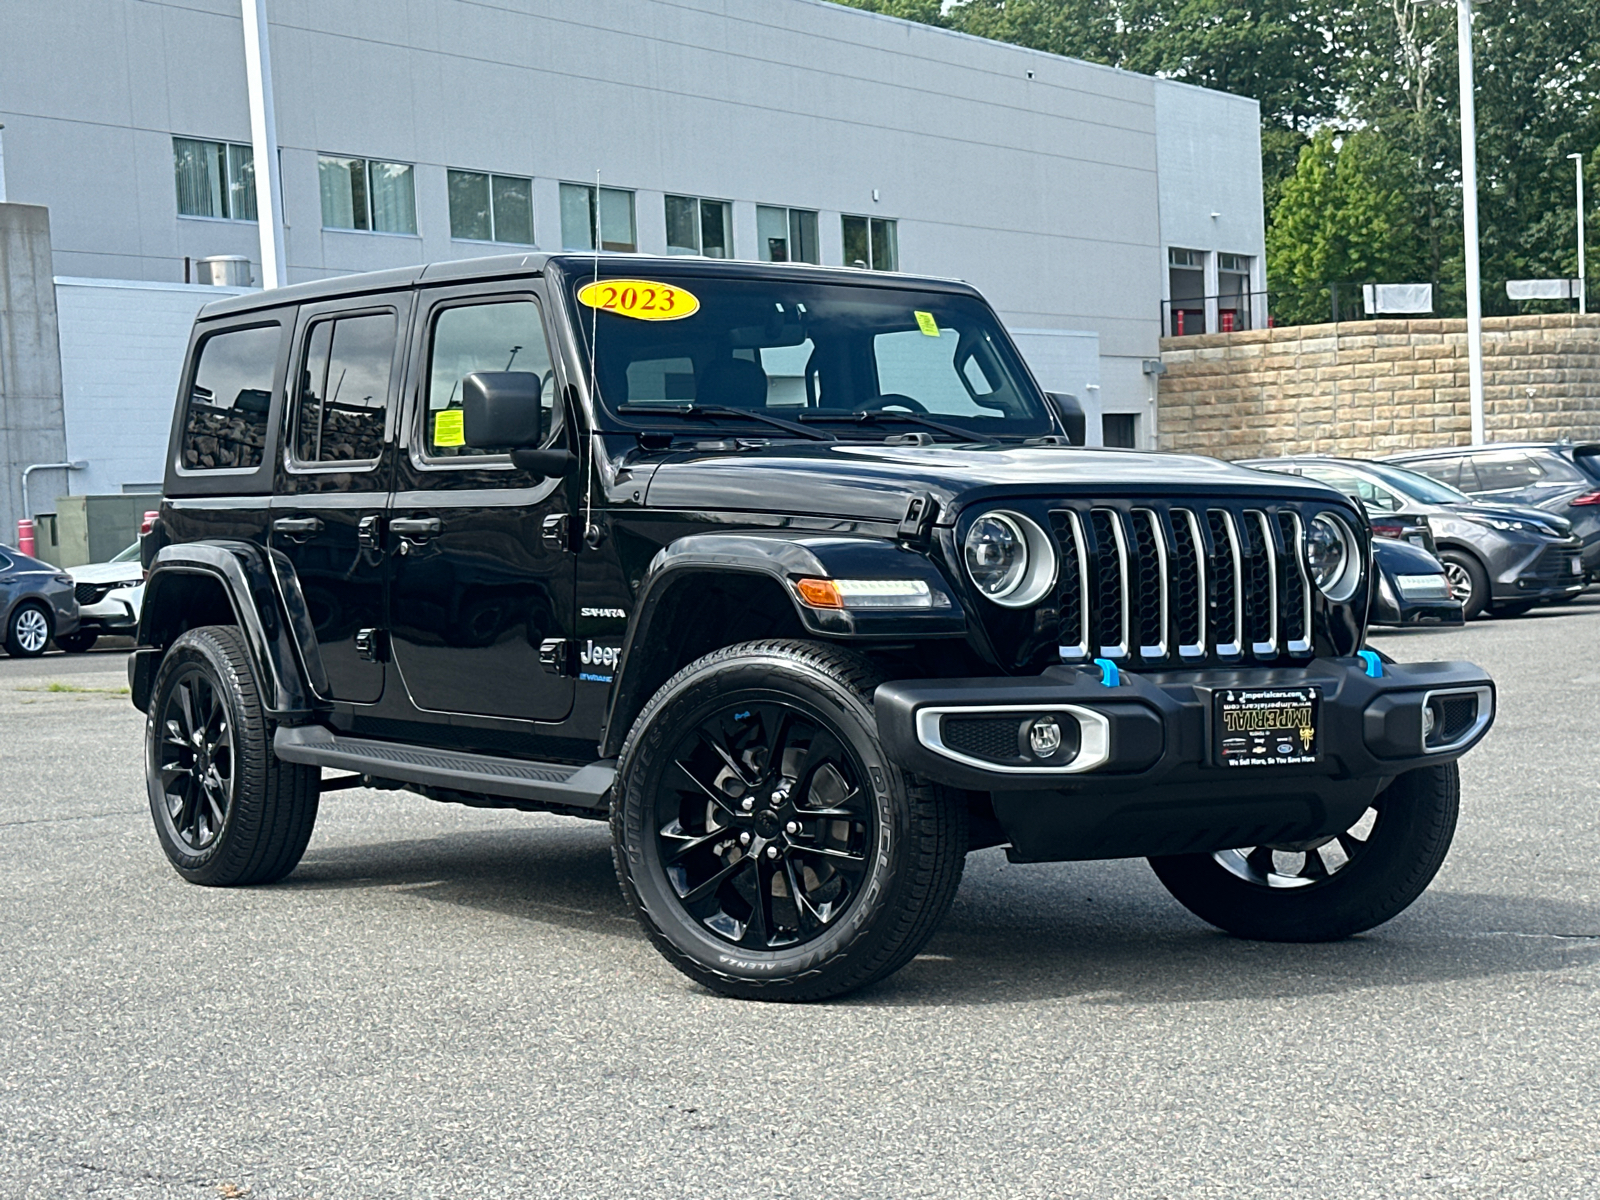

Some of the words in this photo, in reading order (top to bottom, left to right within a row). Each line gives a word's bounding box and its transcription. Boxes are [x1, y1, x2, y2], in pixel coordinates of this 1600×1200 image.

[602, 287, 675, 311] 2023
[581, 607, 627, 618] SAHARA
[1224, 708, 1312, 731] IMPERIAL
[719, 955, 777, 970] ALENZA
